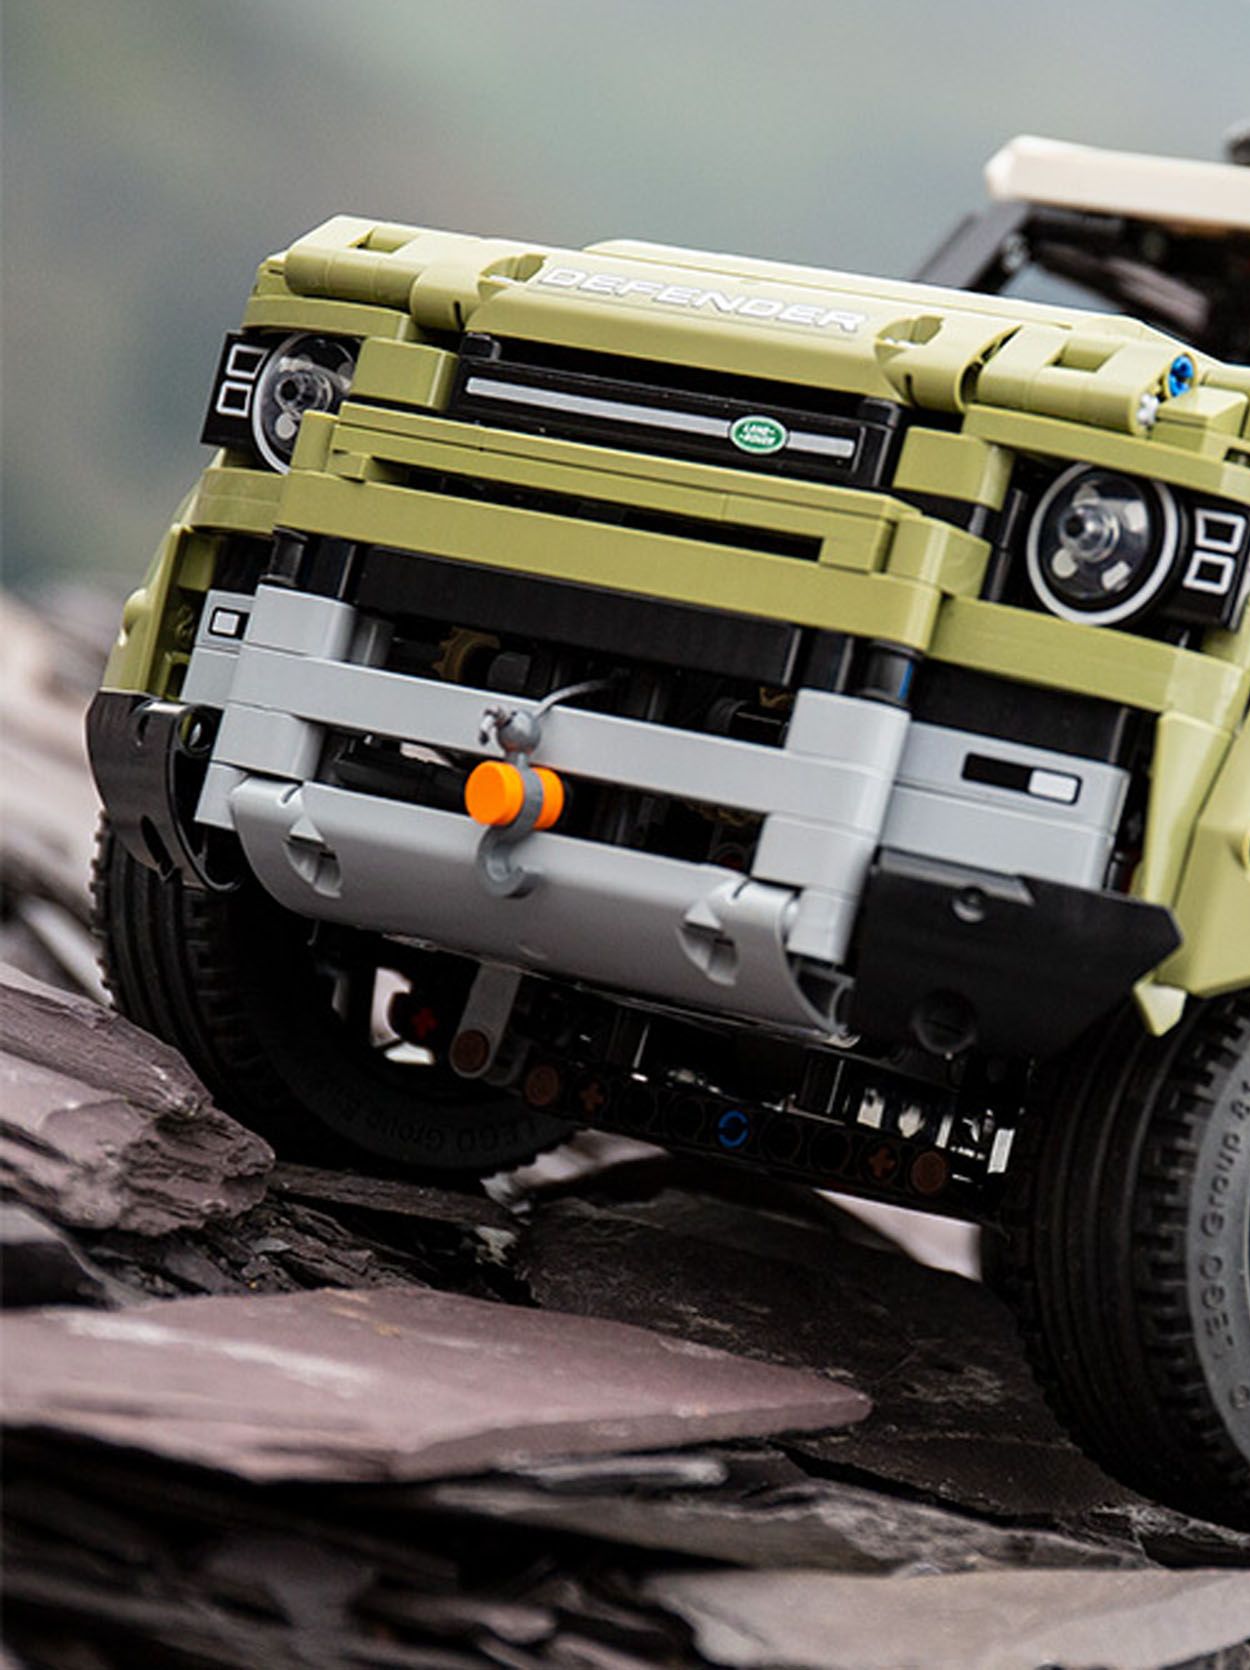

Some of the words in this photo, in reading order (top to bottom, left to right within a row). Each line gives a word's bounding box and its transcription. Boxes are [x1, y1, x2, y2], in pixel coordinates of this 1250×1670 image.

[540, 267, 867, 332] DEFENDER
[1201, 1133, 1241, 1239] Group
[1200, 1254, 1235, 1360] LEGO
